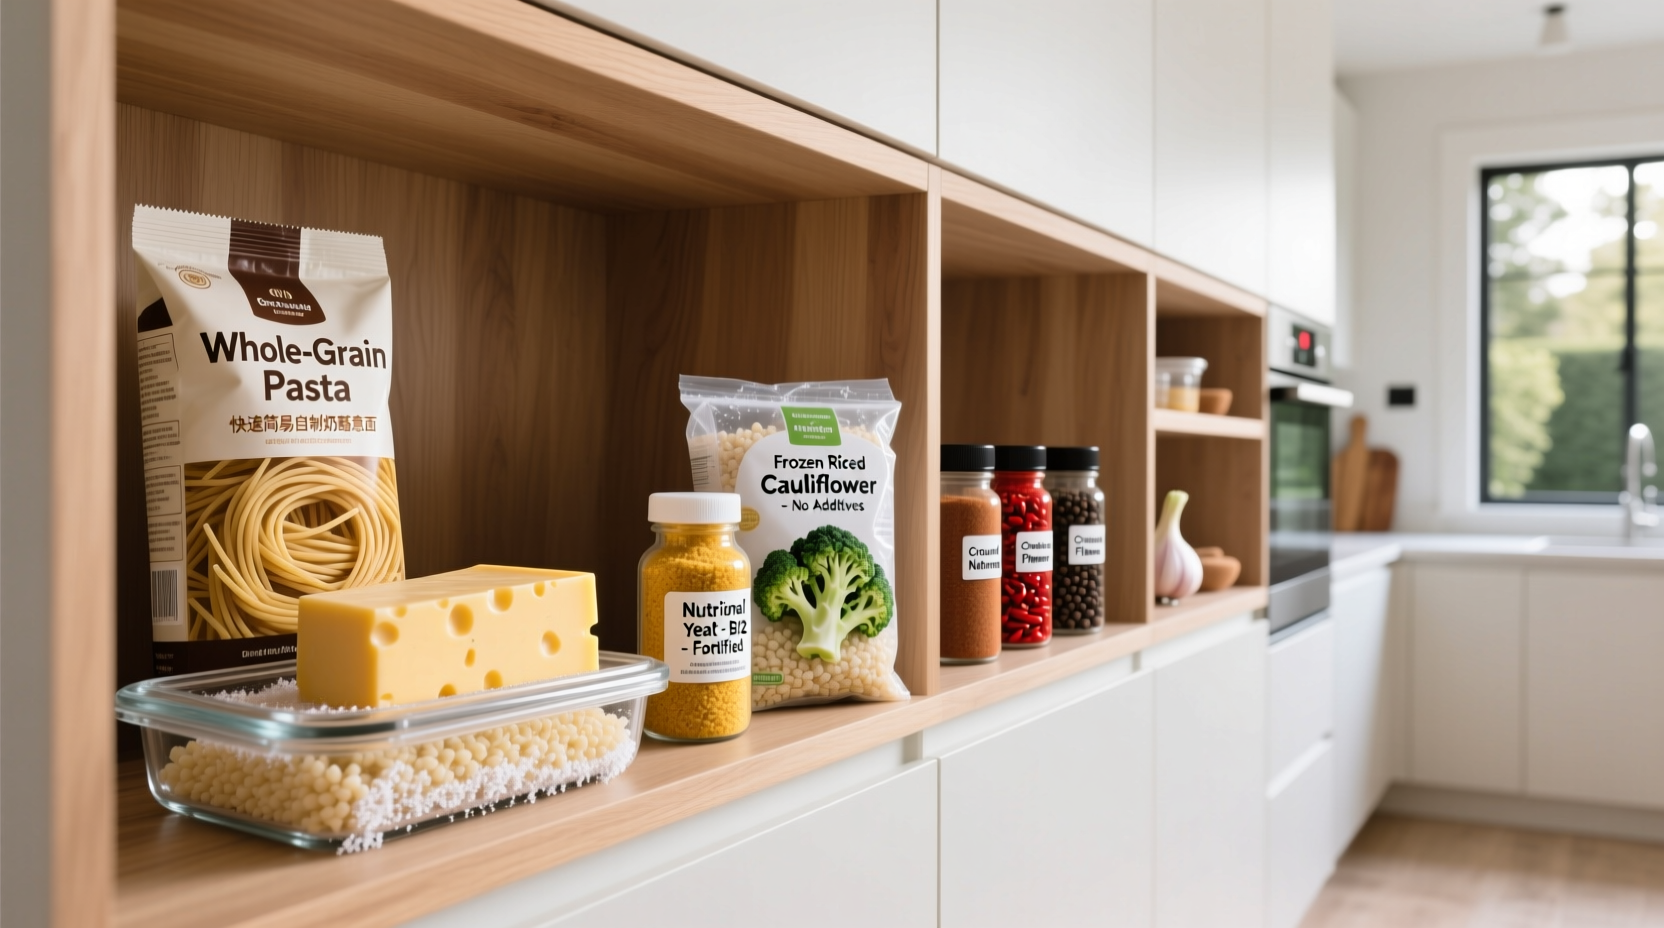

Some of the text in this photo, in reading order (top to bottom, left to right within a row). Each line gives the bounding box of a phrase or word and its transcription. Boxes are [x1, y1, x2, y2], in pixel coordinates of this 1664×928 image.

[200, 331, 387, 369] Whole-Grain
[263, 369, 351, 402] Pasta
[774, 454, 866, 470] Frozen Riced
[760, 473, 877, 495] Cauliflower
[792, 499, 809, 512] No
